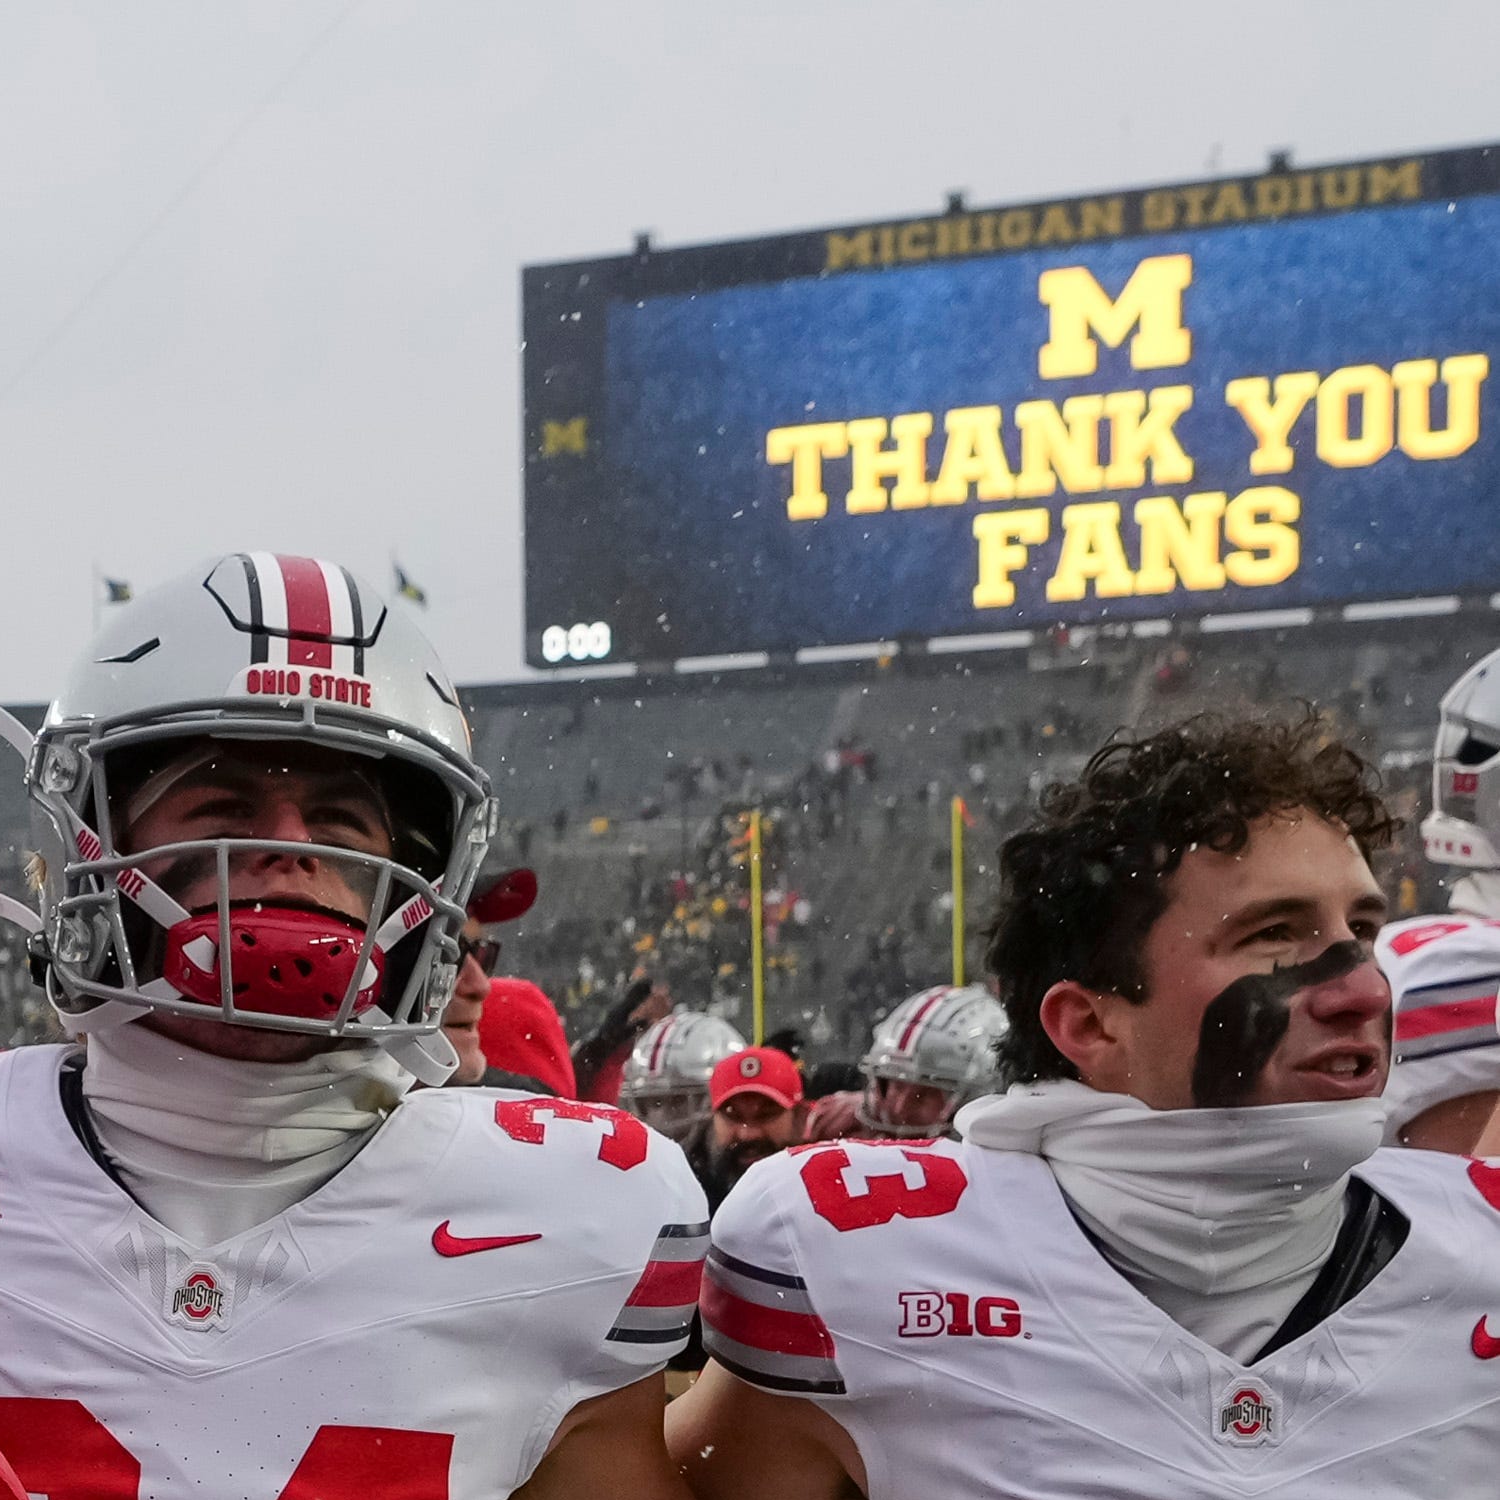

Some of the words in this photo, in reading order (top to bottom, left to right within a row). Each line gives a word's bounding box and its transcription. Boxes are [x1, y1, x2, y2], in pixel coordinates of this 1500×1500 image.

[825, 199, 1125, 271] MICHIGAN
[1143, 160, 1424, 233] STADIUM
[1037, 253, 1194, 380] M
[765, 385, 1195, 521] THANK
[1226, 353, 1490, 477] YOU
[972, 485, 1303, 609] FANS
[247, 669, 301, 696] OHIO
[310, 673, 372, 708] STATE
